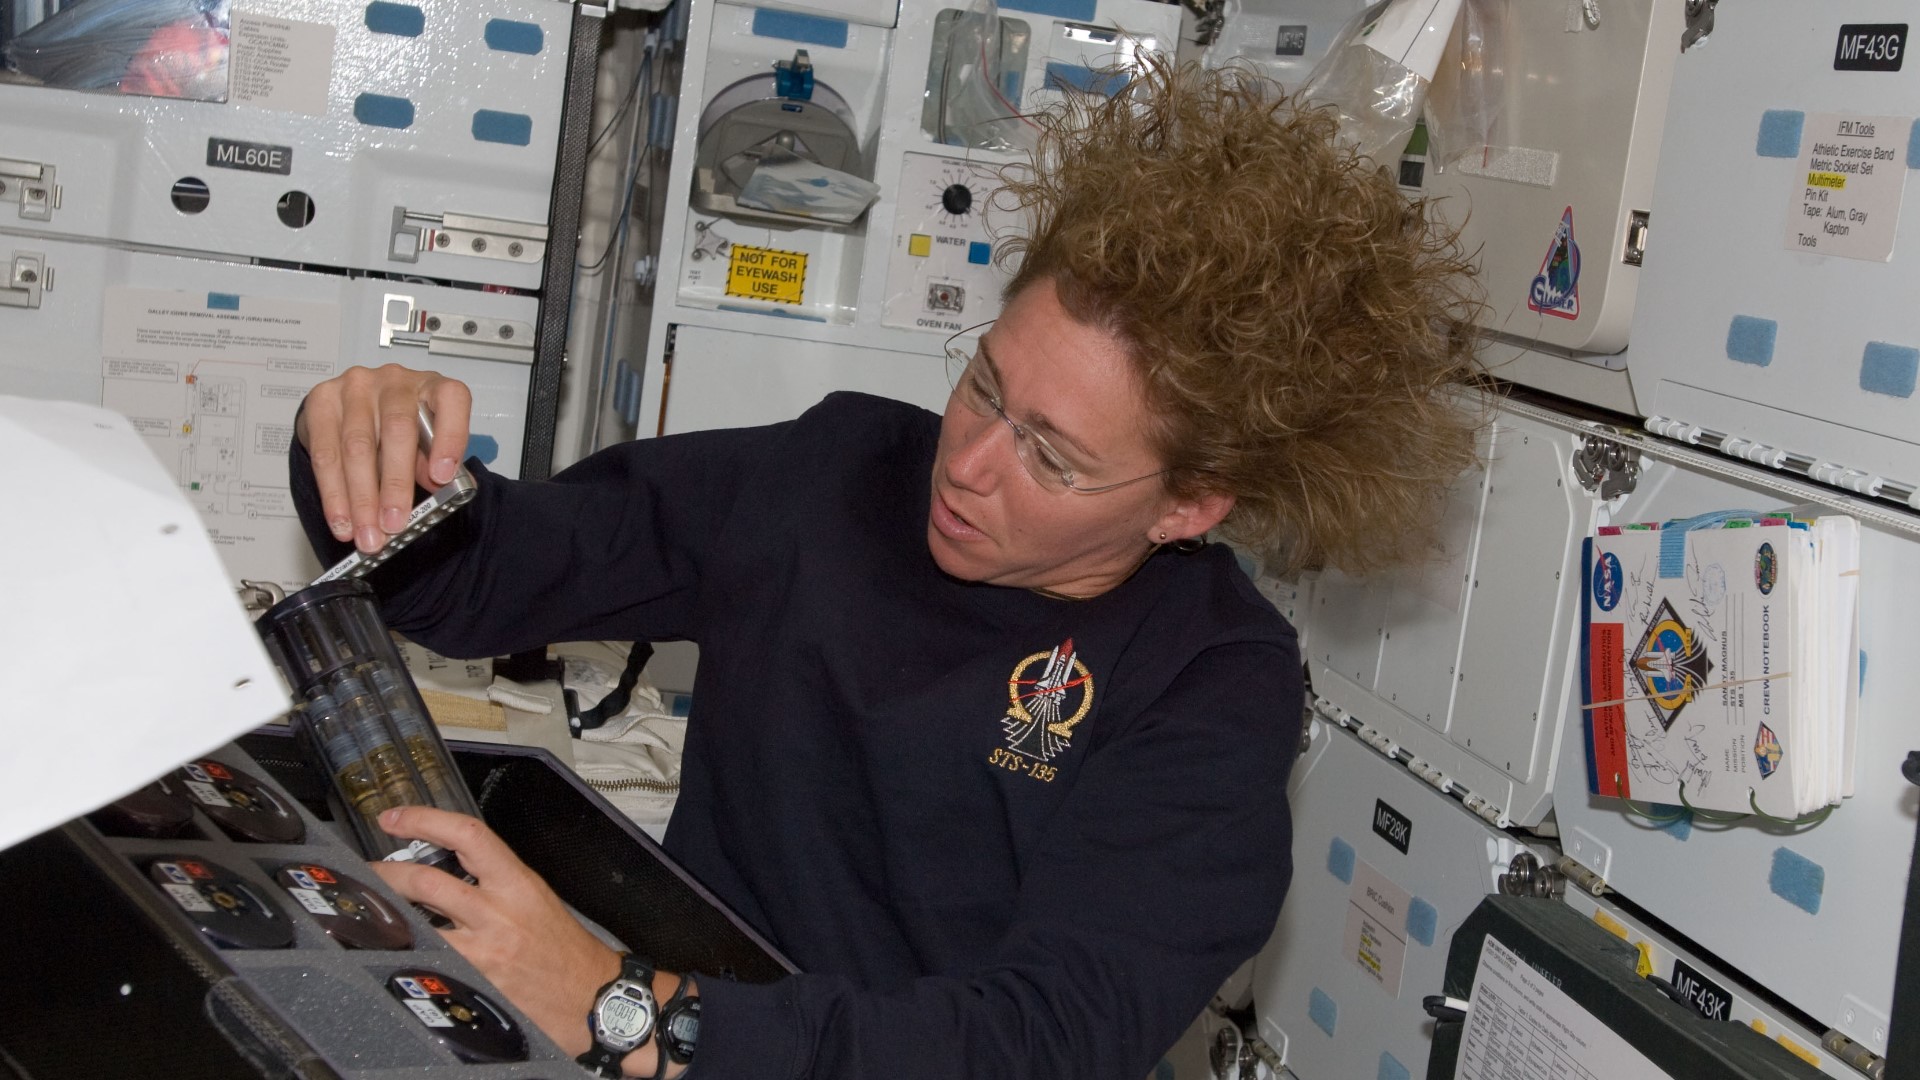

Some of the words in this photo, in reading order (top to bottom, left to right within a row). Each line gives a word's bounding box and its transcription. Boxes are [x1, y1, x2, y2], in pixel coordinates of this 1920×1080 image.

[1840, 34, 1900, 60] MF43G
[1838, 121, 1853, 133] IFM
[1855, 122, 1875, 135] Tools
[217, 144, 282, 168] ML60E
[1813, 143, 1840, 157] Athletic
[1841, 145, 1872, 159] Exercise
[1874, 147, 1895, 161] Band
[1810, 158, 1832, 172] Metric
[1834, 160, 1859, 174] Socket
[1861, 162, 1874, 175] Set
[1807, 173, 1846, 188] Multimeter
[1805, 189, 1817, 201] Pin
[1818, 190, 1829, 202] Kit
[1803, 203, 1822, 218] Tape:
[1826, 206, 1847, 221] Alum,
[1849, 208, 1868, 225] Gray
[1824, 221, 1849, 236] Kapton
[935, 235, 967, 246] WATER
[1798, 233, 1817, 248] Tools
[740, 252, 767, 265] NOT
[770, 256, 797, 269] FOR
[736, 265, 798, 283] EYEWASH
[752, 281, 778, 294] USE
[917, 318, 942, 329] OVEN
[944, 321, 962, 331] FAN
[334, 559, 354, 574] Crank
[1603, 556, 1611, 607] NASA
[1721, 674, 1729, 706] SANY
[1738, 693, 1745, 707] MS
[1602, 696, 1610, 738] NATIONL
[988, 748, 1058, 782] STS-135
[1376, 807, 1408, 845] MF28K
[1676, 971, 1726, 1021] MF43K
